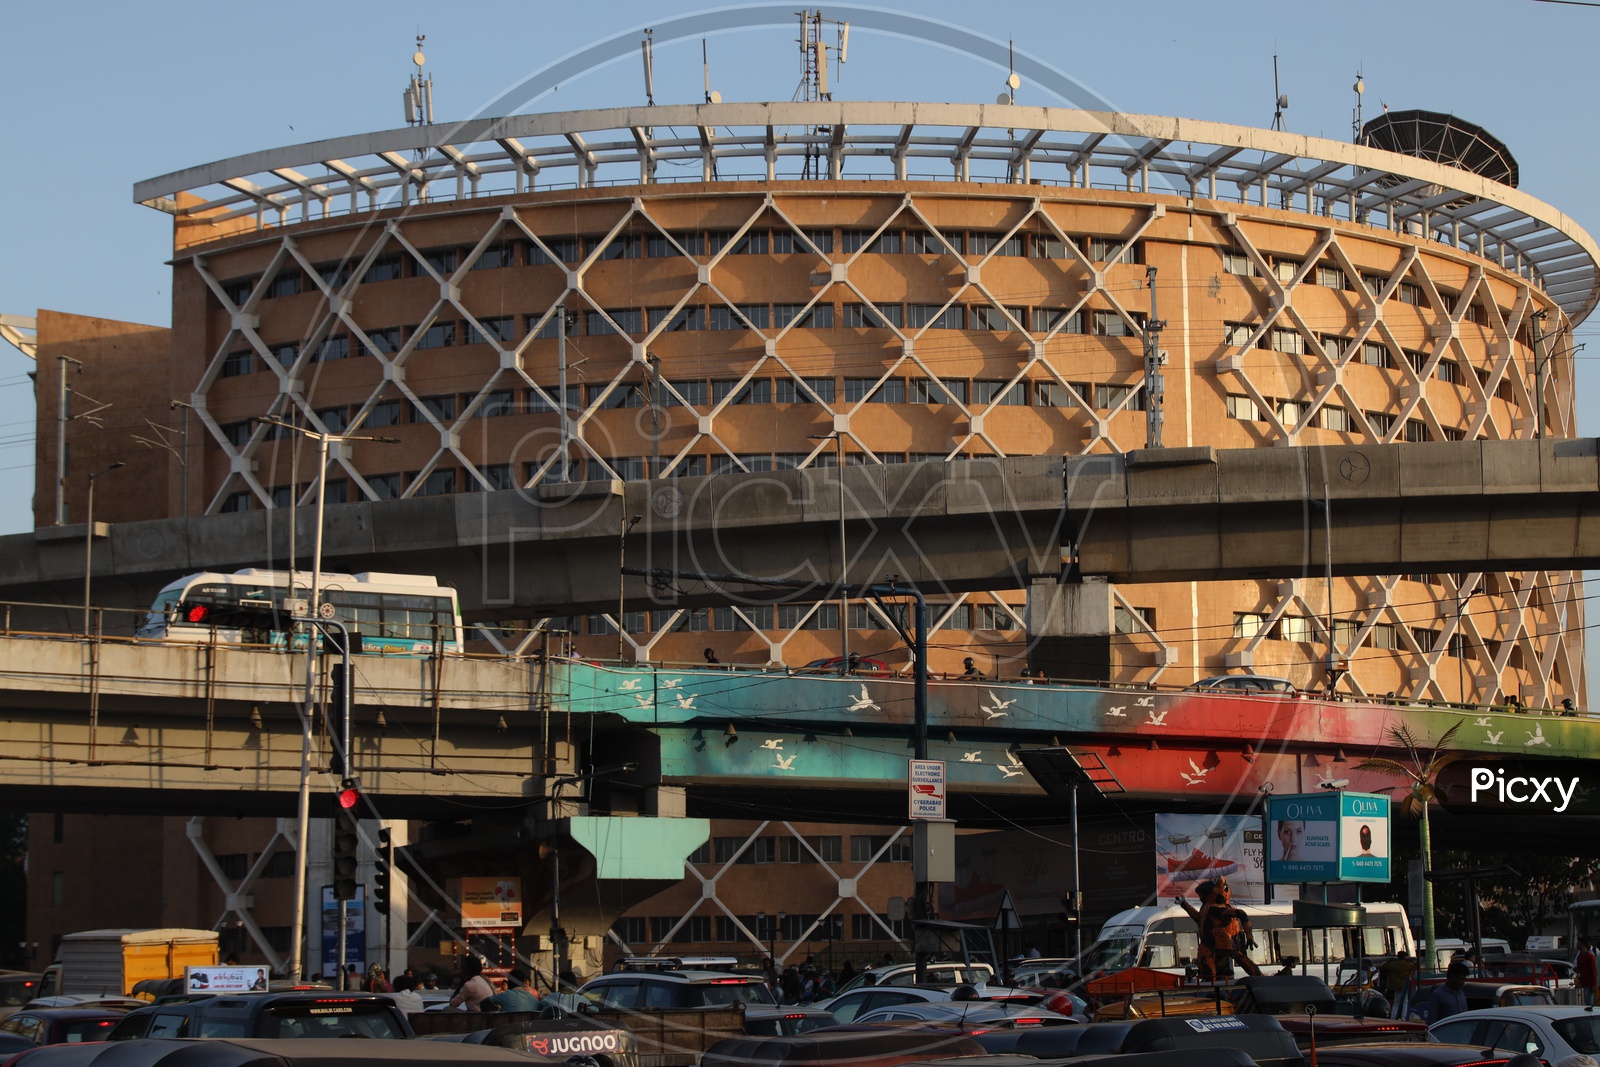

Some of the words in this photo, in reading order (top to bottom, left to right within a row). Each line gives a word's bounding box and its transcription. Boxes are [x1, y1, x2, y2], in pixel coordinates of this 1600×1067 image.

[1286, 803, 1322, 819] OLIVA
[1352, 799, 1378, 815] OLIVA
[1098, 829, 1145, 845] CENTRO
[1243, 848, 1256, 856] FLY
